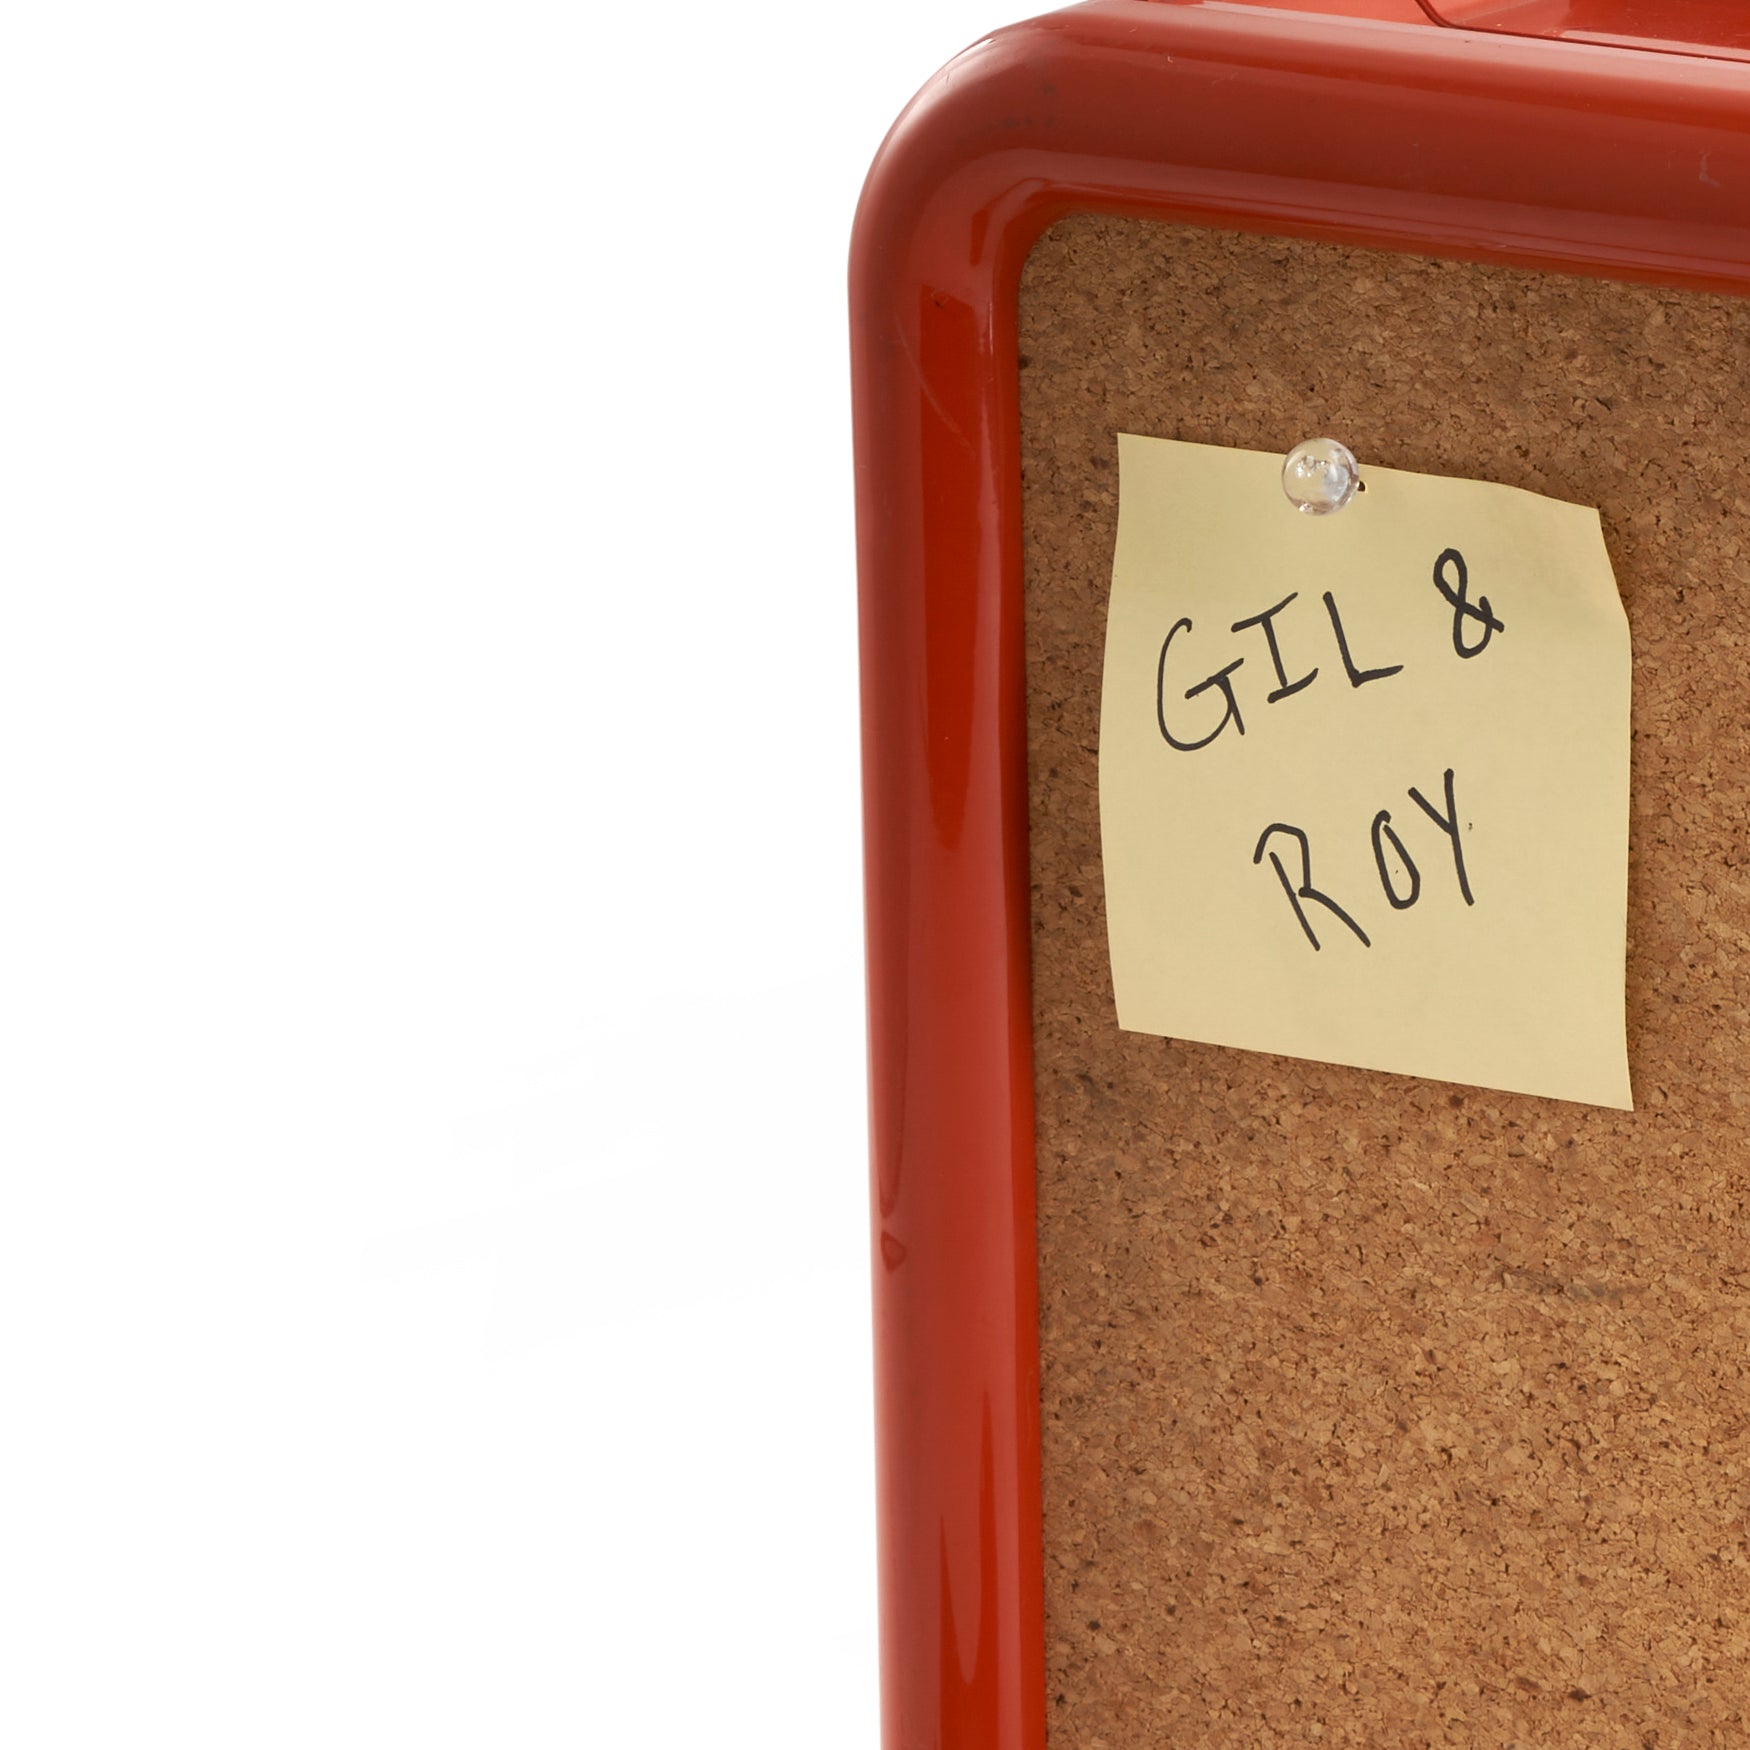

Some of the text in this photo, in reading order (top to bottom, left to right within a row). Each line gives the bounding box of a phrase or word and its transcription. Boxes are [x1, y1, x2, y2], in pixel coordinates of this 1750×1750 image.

[1156, 547, 1504, 751] GIL &
[1253, 767, 1475, 951] ROY
